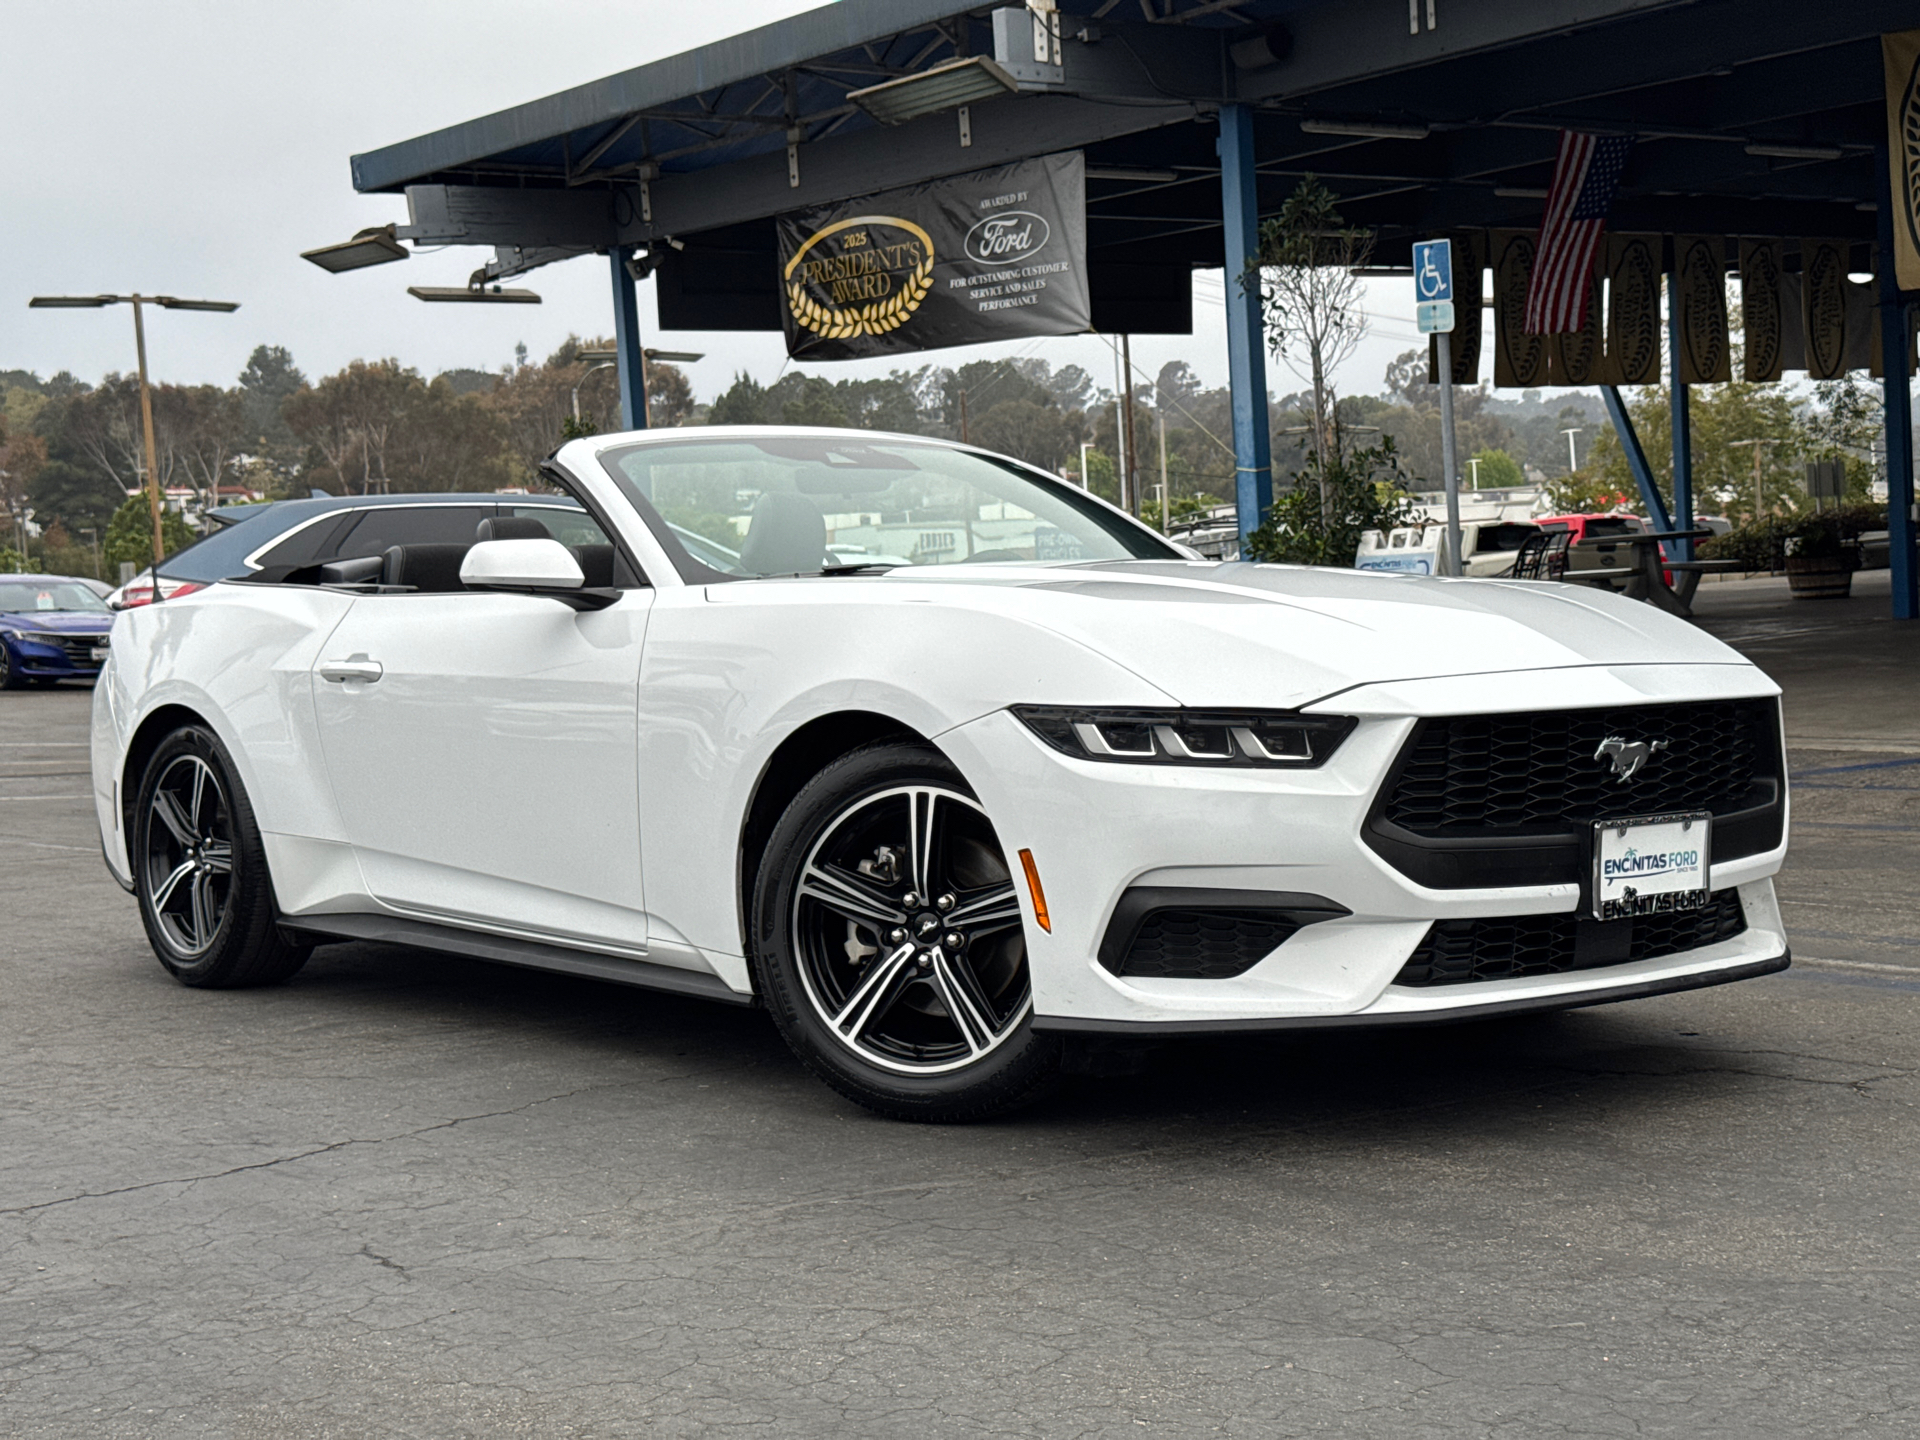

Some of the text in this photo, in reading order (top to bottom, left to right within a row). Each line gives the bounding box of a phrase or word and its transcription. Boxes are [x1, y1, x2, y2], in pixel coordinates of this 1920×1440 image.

[979, 191, 1029, 210] AWARDED BY
[843, 231, 868, 249] 2025
[979, 218, 1033, 257] Ford
[800, 241, 920, 285] PRESIDENT'S
[949, 261, 1069, 289] FOR OUTSTANDING CUSTOMER
[828, 272, 891, 305] AWARD
[969, 279, 1047, 300] SERVICE AND SALES
[978, 294, 1039, 312] PERFORMANCE
[1604, 850, 1698, 875] ENCINITAS FORD
